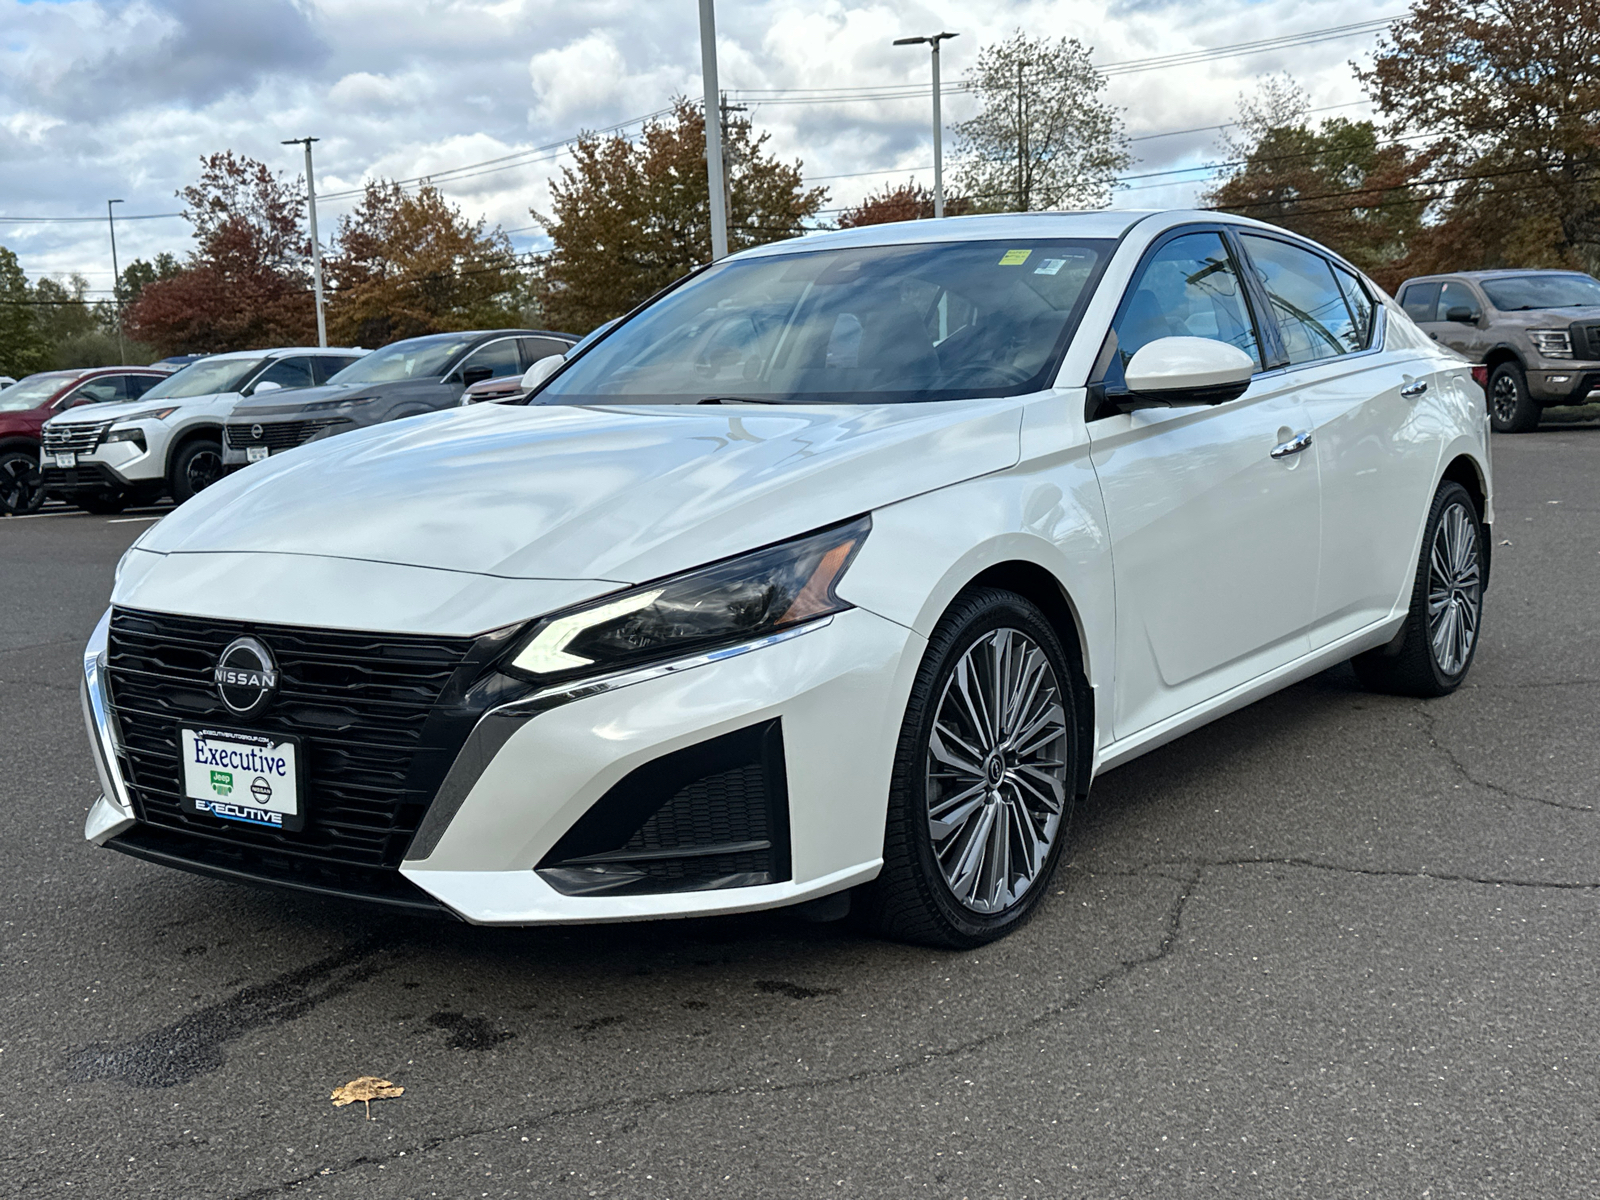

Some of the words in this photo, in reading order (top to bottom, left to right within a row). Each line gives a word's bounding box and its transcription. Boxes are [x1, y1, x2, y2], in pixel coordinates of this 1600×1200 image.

[214, 669, 275, 687] NISSAN
[193, 738, 286, 777] Executive
[213, 773, 230, 783] Jeep
[252, 786, 271, 794] NISSAN
[195, 799, 283, 825] EXECUTIVE
